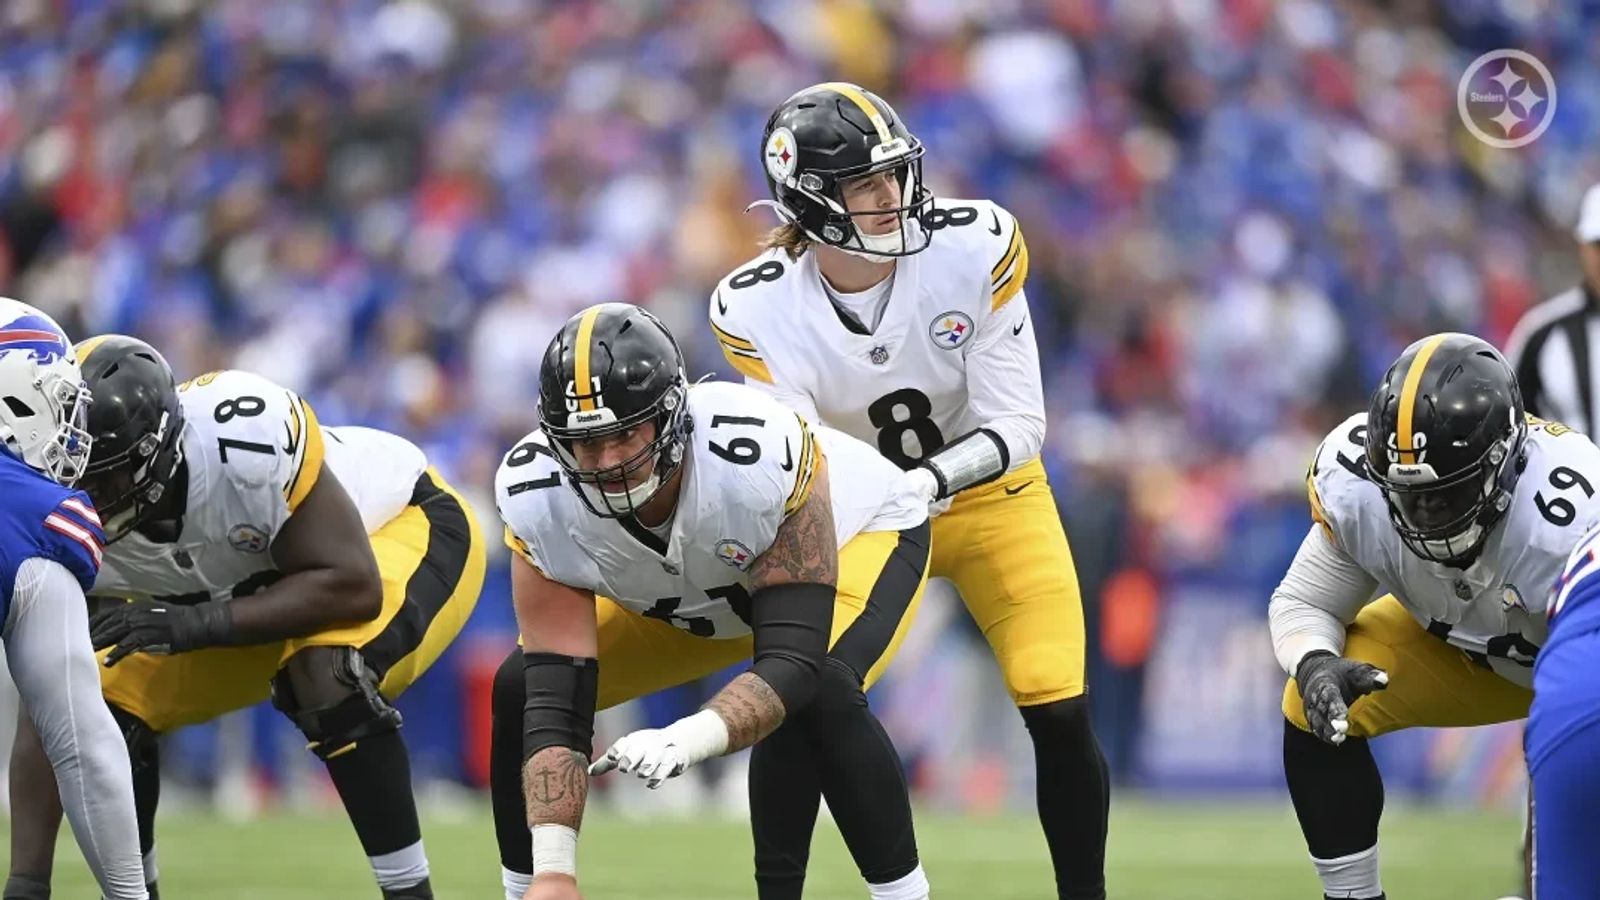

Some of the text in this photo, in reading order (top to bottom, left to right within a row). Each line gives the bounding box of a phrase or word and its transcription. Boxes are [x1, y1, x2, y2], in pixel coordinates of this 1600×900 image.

[922, 207, 979, 230] 8
[729, 261, 784, 290] 8
[566, 375, 604, 412] 61
[214, 396, 276, 464] 78
[708, 413, 767, 465] 61
[868, 389, 944, 471] 8
[506, 441, 562, 496] 61
[1533, 466, 1597, 528] 69
